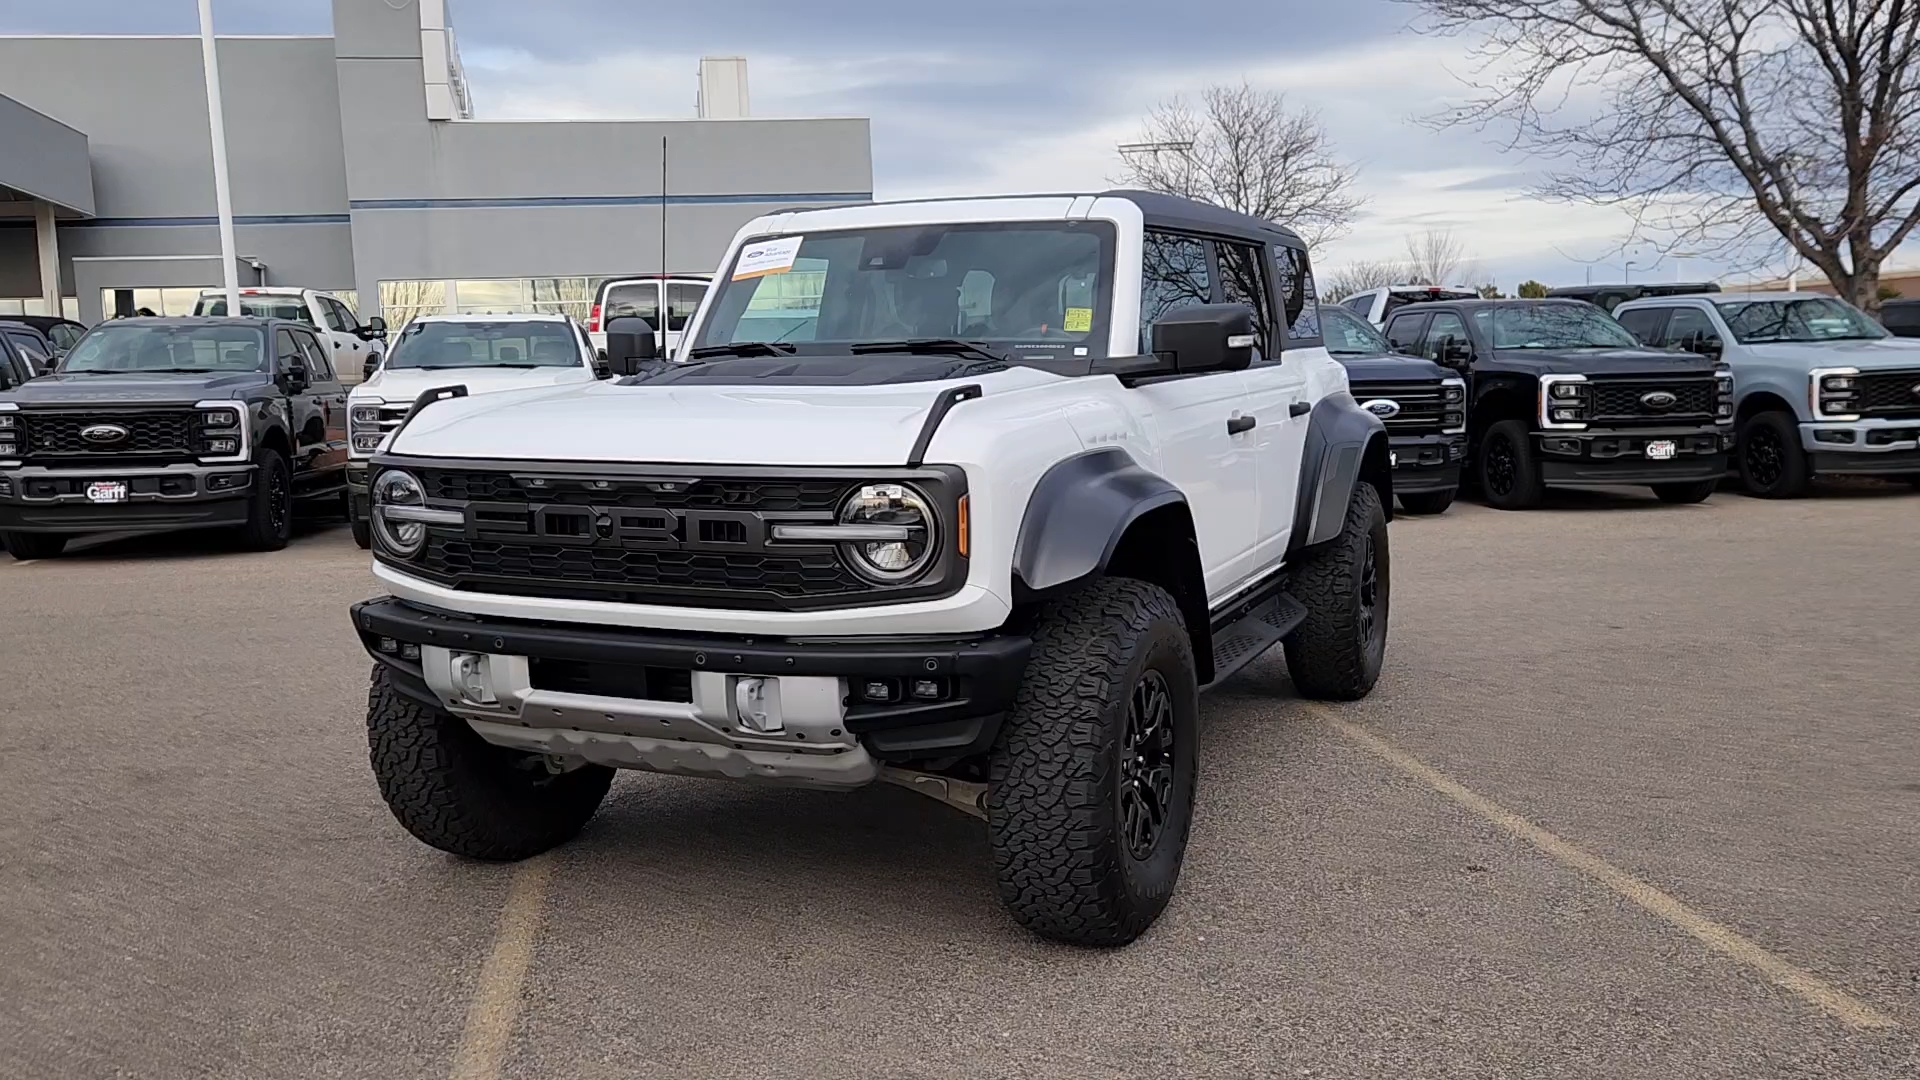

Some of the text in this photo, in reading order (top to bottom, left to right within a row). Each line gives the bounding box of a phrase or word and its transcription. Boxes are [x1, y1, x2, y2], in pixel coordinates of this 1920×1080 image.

[1646, 442, 1675, 457] Garff
[86, 485, 126, 500] Garff
[463, 501, 765, 551] FORD
